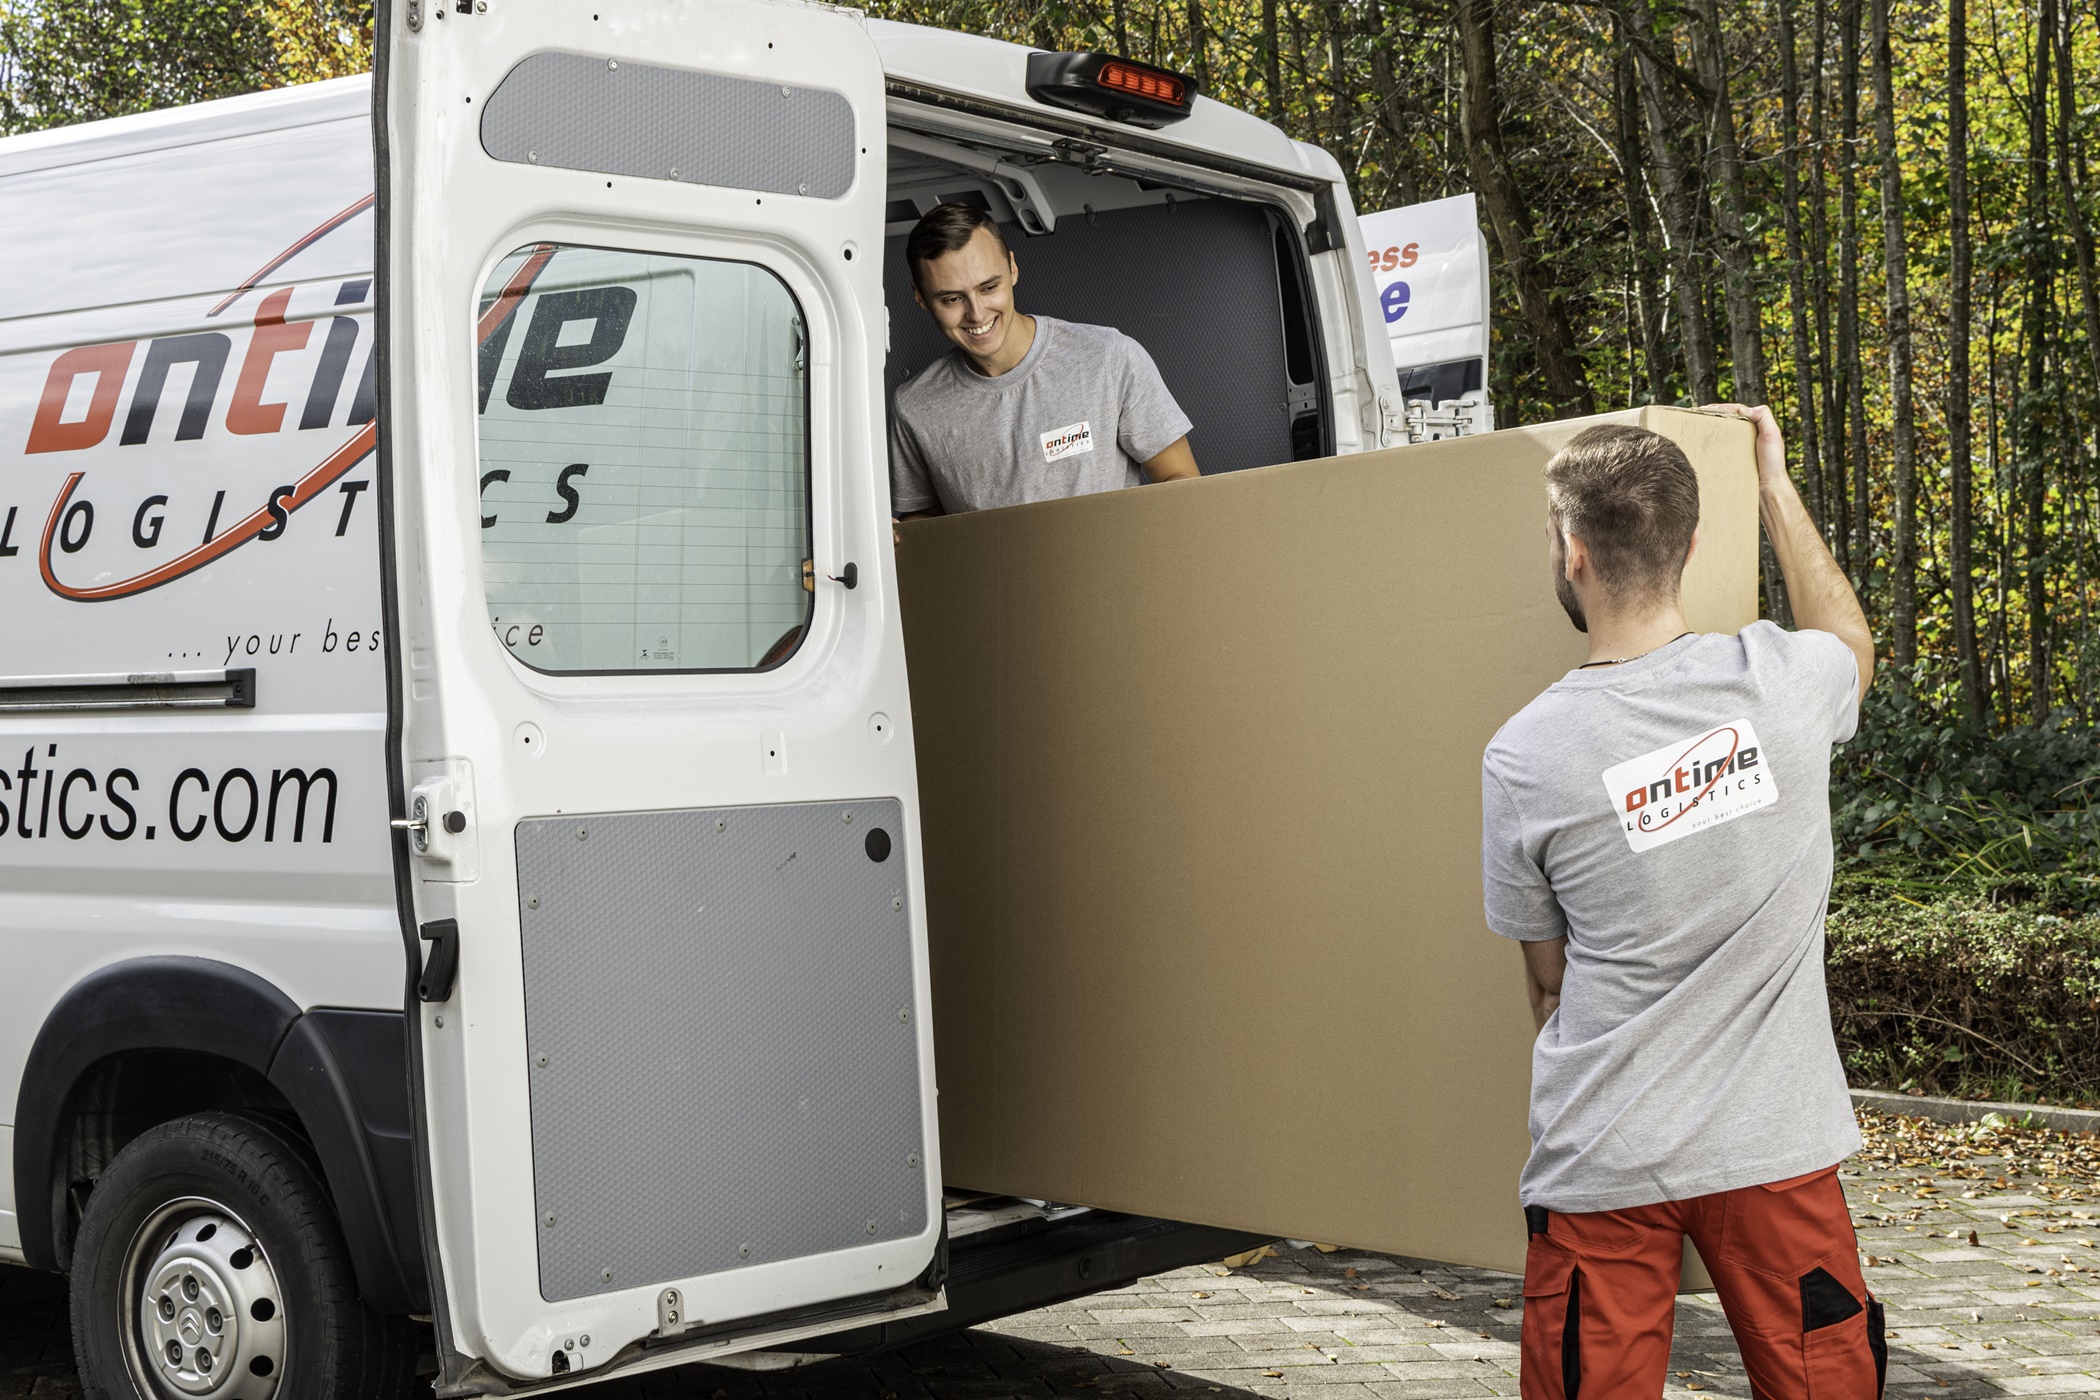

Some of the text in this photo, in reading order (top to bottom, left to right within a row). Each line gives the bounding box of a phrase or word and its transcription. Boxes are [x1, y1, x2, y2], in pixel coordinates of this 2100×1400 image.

[1046, 431, 1089, 449] ontime
[223, 632, 302, 667] your
[322, 618, 381, 653] bes
[1625, 746, 1759, 813] ontime
[1627, 773, 1761, 832] LOGISTICS
[1692, 798, 1762, 829] your best choice
[200, 1148, 270, 1207] 215/75 R 16 C
